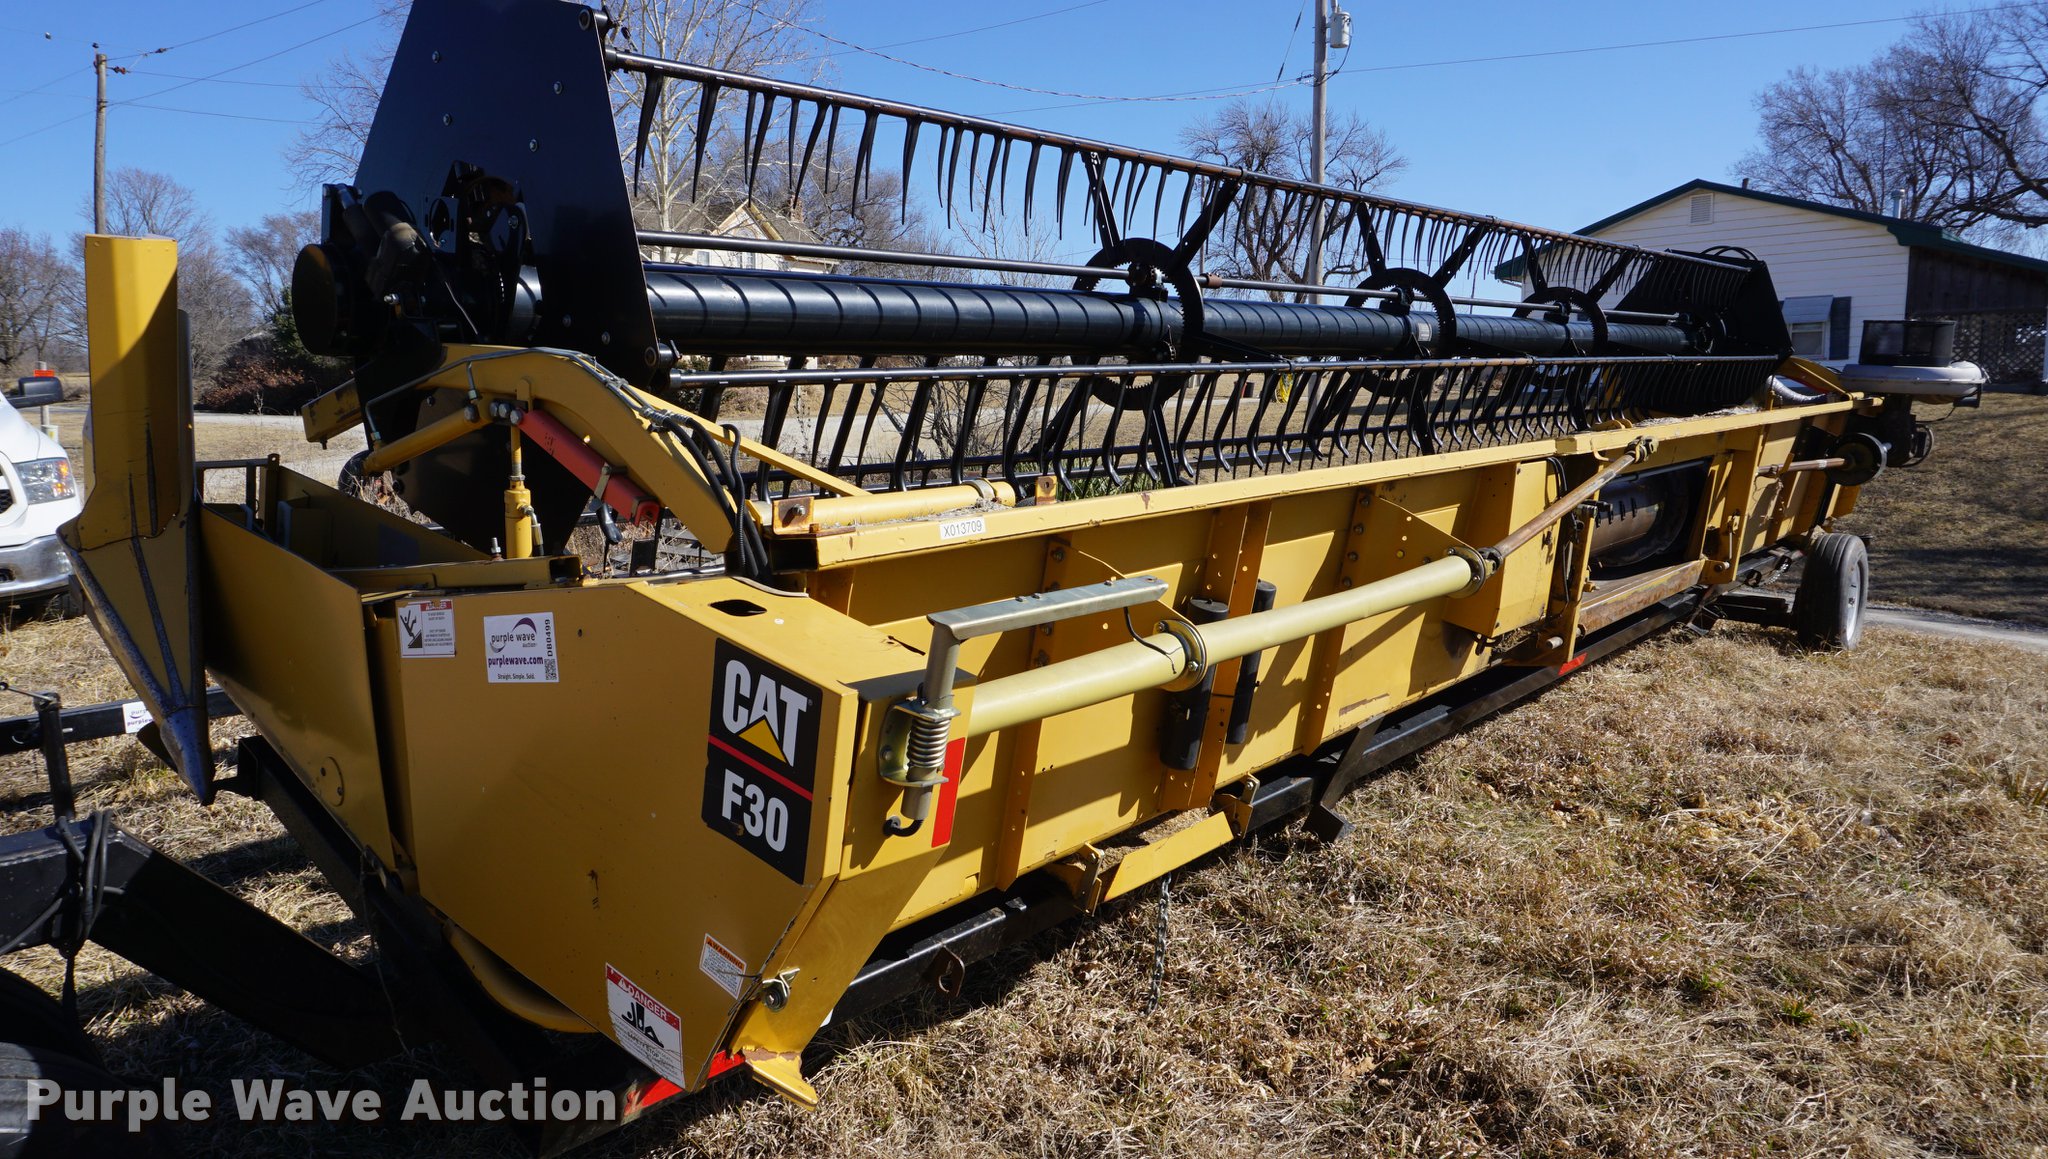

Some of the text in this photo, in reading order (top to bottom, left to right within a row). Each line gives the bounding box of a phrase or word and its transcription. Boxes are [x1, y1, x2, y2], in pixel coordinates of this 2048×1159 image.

[944, 521, 982, 537] X013709
[491, 632, 536, 644] purple wave
[488, 655, 544, 668] purplewave.com
[722, 659, 808, 767] CAT
[722, 768, 789, 852] F30
[628, 984, 668, 1021] DANGER
